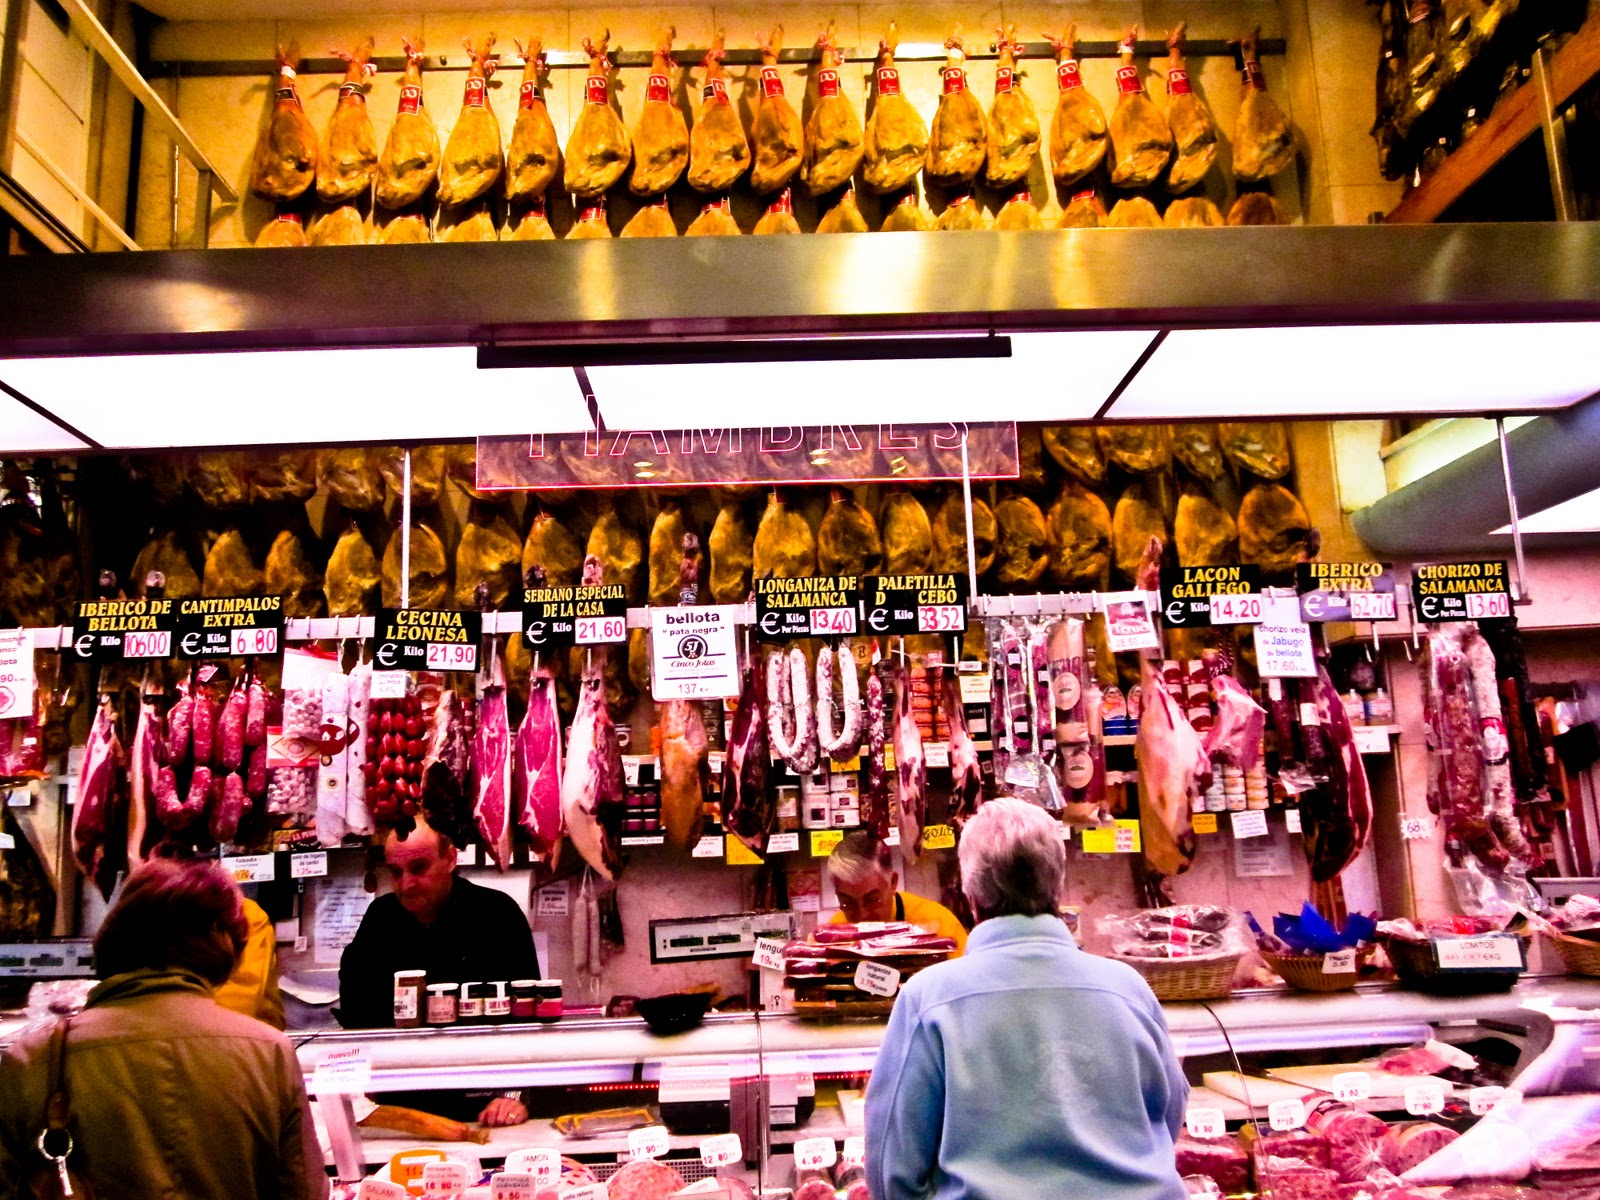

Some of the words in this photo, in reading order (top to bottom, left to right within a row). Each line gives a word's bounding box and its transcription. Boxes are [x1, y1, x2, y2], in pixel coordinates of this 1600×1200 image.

[820, 72, 836, 82] DO
[881, 70, 897, 79] DO
[945, 69, 961, 79] DO
[589, 79, 606, 88] DO
[1184, 567, 1240, 584] LACON
[1310, 563, 1383, 577] IBERICO
[1418, 565, 1480, 579] CHORIZO
[1484, 563, 1502, 577] DE
[759, 578, 836, 594] LONGANIZA
[838, 576, 857, 591] DE
[878, 575, 956, 591] PALETILLA
[1319, 578, 1374, 592] EXTRA
[1420, 579, 1504, 595] SALAMANCA
[524, 588, 573, 604] SERRANO
[575, 585, 624, 601] ESPECIAL
[918, 589, 957, 604] CEBO
[1172, 582, 1250, 599] GALLEGO
[181, 597, 280, 614] CANTIMPALOS
[766, 591, 847, 608] SALAMANCA
[1327, 596, 1347, 607] Kilo
[1443, 597, 1462, 608] Kilo
[80, 601, 147, 617] IBERICO
[149, 600, 172, 614] DE
[543, 603, 559, 618] DE
[560, 602, 574, 617] LA
[576, 601, 604, 616] CASA
[1190, 602, 1210, 612] Kilo
[203, 613, 256, 627] EXTRA
[396, 611, 463, 627] CECINA
[666, 611, 720, 625] bellota
[785, 613, 806, 623] Kilo
[894, 609, 914, 620] Kilo
[88, 615, 158, 632] BELLOTA
[552, 622, 572, 633] Kilo
[578, 621, 623, 639] 21,60
[1259, 624, 1288, 633] chorizo
[206, 633, 227, 644] Kilo
[386, 626, 468, 642] LEONESA
[669, 628, 690, 637] pata
[692, 626, 718, 635] negra
[100, 636, 121, 646] Kilo
[1271, 636, 1304, 648] Jabugo
[404, 645, 424, 656] Kilo
[429, 645, 475, 665] 21,90
[1276, 649, 1302, 657] bellota
[671, 660, 694, 668] Cinco
[677, 683, 697, 694] 137
[759, 941, 782, 955] lengu
[1460, 941, 1495, 949] LOMITOS
